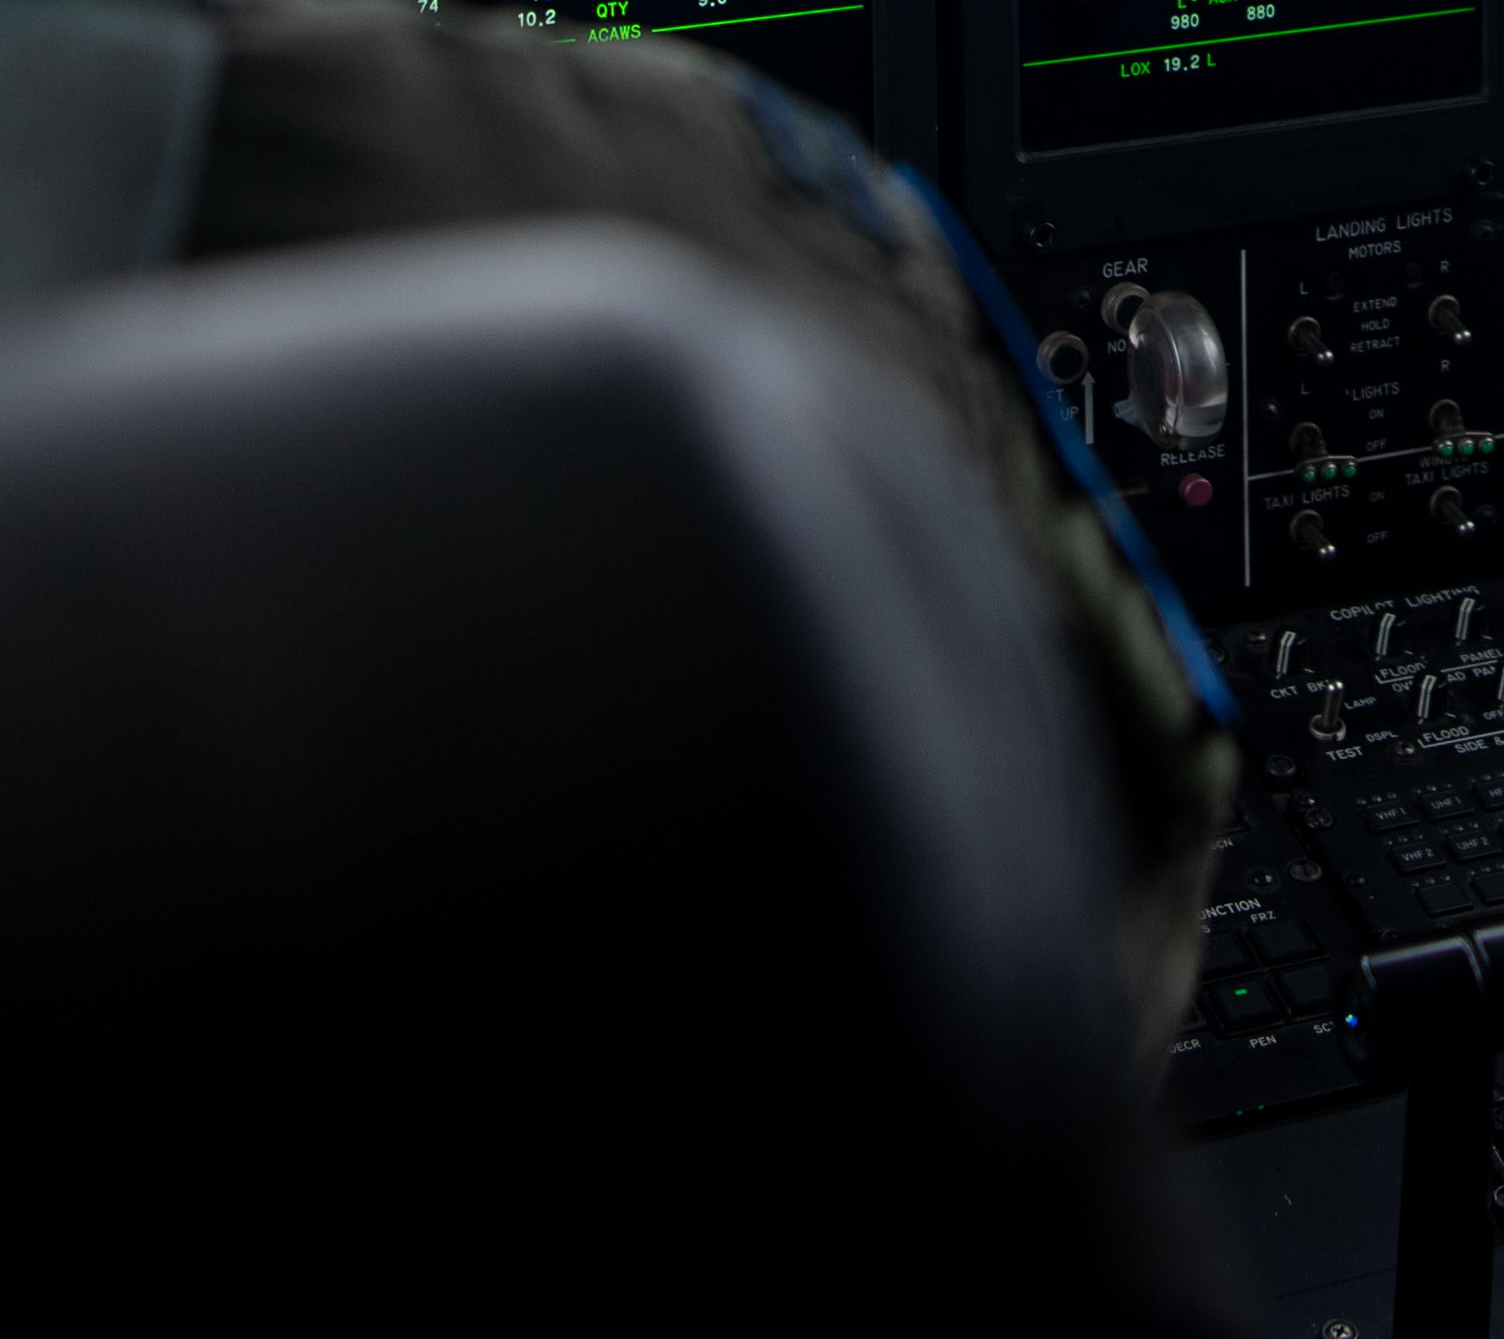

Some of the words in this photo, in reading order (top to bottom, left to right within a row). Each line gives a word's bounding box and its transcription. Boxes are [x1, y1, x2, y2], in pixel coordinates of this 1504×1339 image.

[597, 1, 628, 18] QTY
[588, 24, 641, 43] ACAWS
[1121, 61, 1150, 78] LOX
[1164, 55, 1199, 71] 19.2
[1316, 217, 1386, 242] LANDING
[1397, 208, 1452, 230] LIGHTS
[1349, 240, 1401, 259] MOTORS
[1103, 258, 1148, 278] GEAR
[1353, 296, 1397, 312] EXTEND
[1361, 318, 1390, 331] HOLD
[1350, 336, 1400, 353] RETRACT
[1353, 382, 1400, 401] LIGHTS
[1161, 444, 1225, 467] RELEASE
[1264, 494, 1294, 509] TAXI
[1302, 485, 1350, 504] LIGHTS
